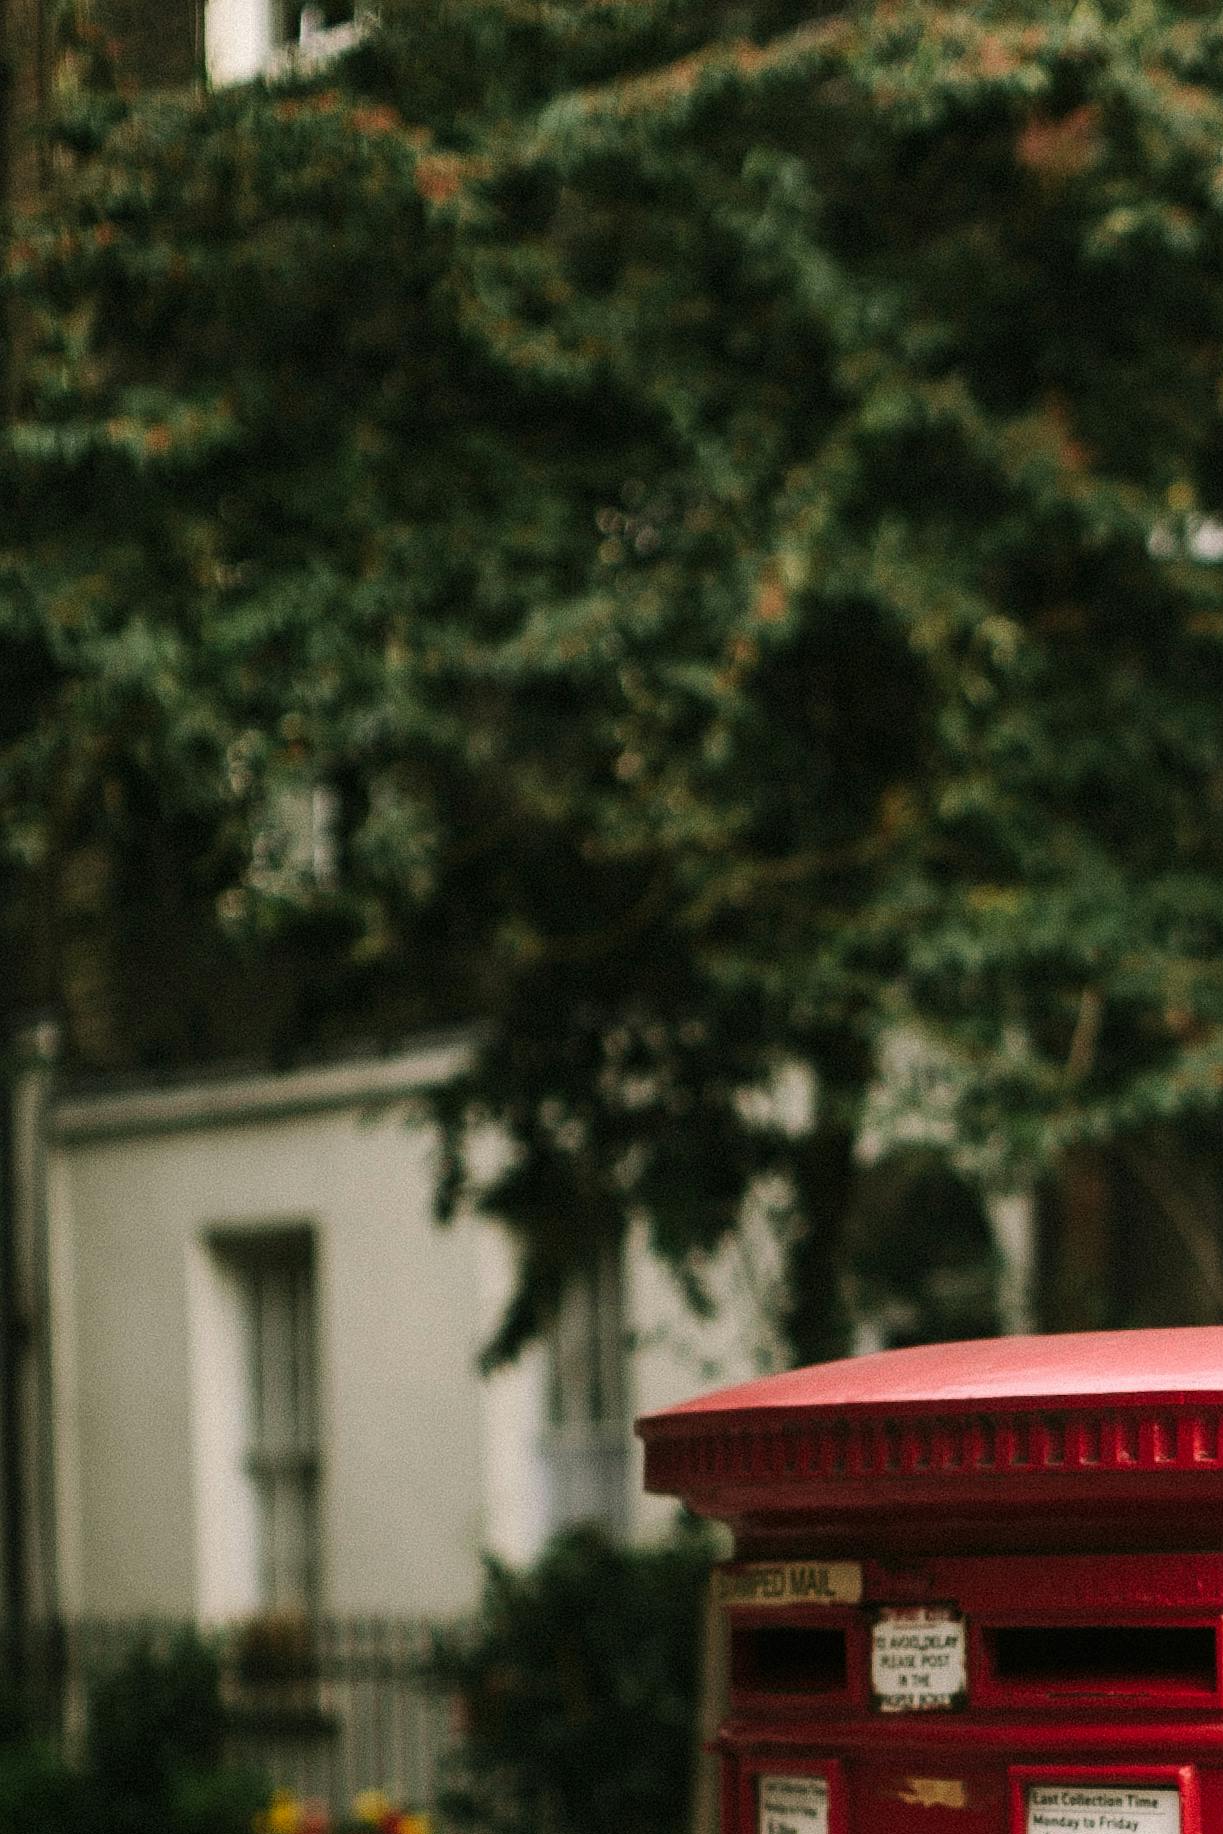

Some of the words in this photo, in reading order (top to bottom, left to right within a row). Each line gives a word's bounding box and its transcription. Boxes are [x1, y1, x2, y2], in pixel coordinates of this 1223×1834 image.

[921, 1653, 950, 1667] POST
[1032, 1789, 1060, 1806] Last
[1062, 1791, 1123, 1808] Collection
[1127, 1793, 1159, 1809] Time
[1033, 1814, 1080, 1830] Monday
[1084, 1815, 1096, 1829] to
[1099, 1815, 1139, 1832] Friday
